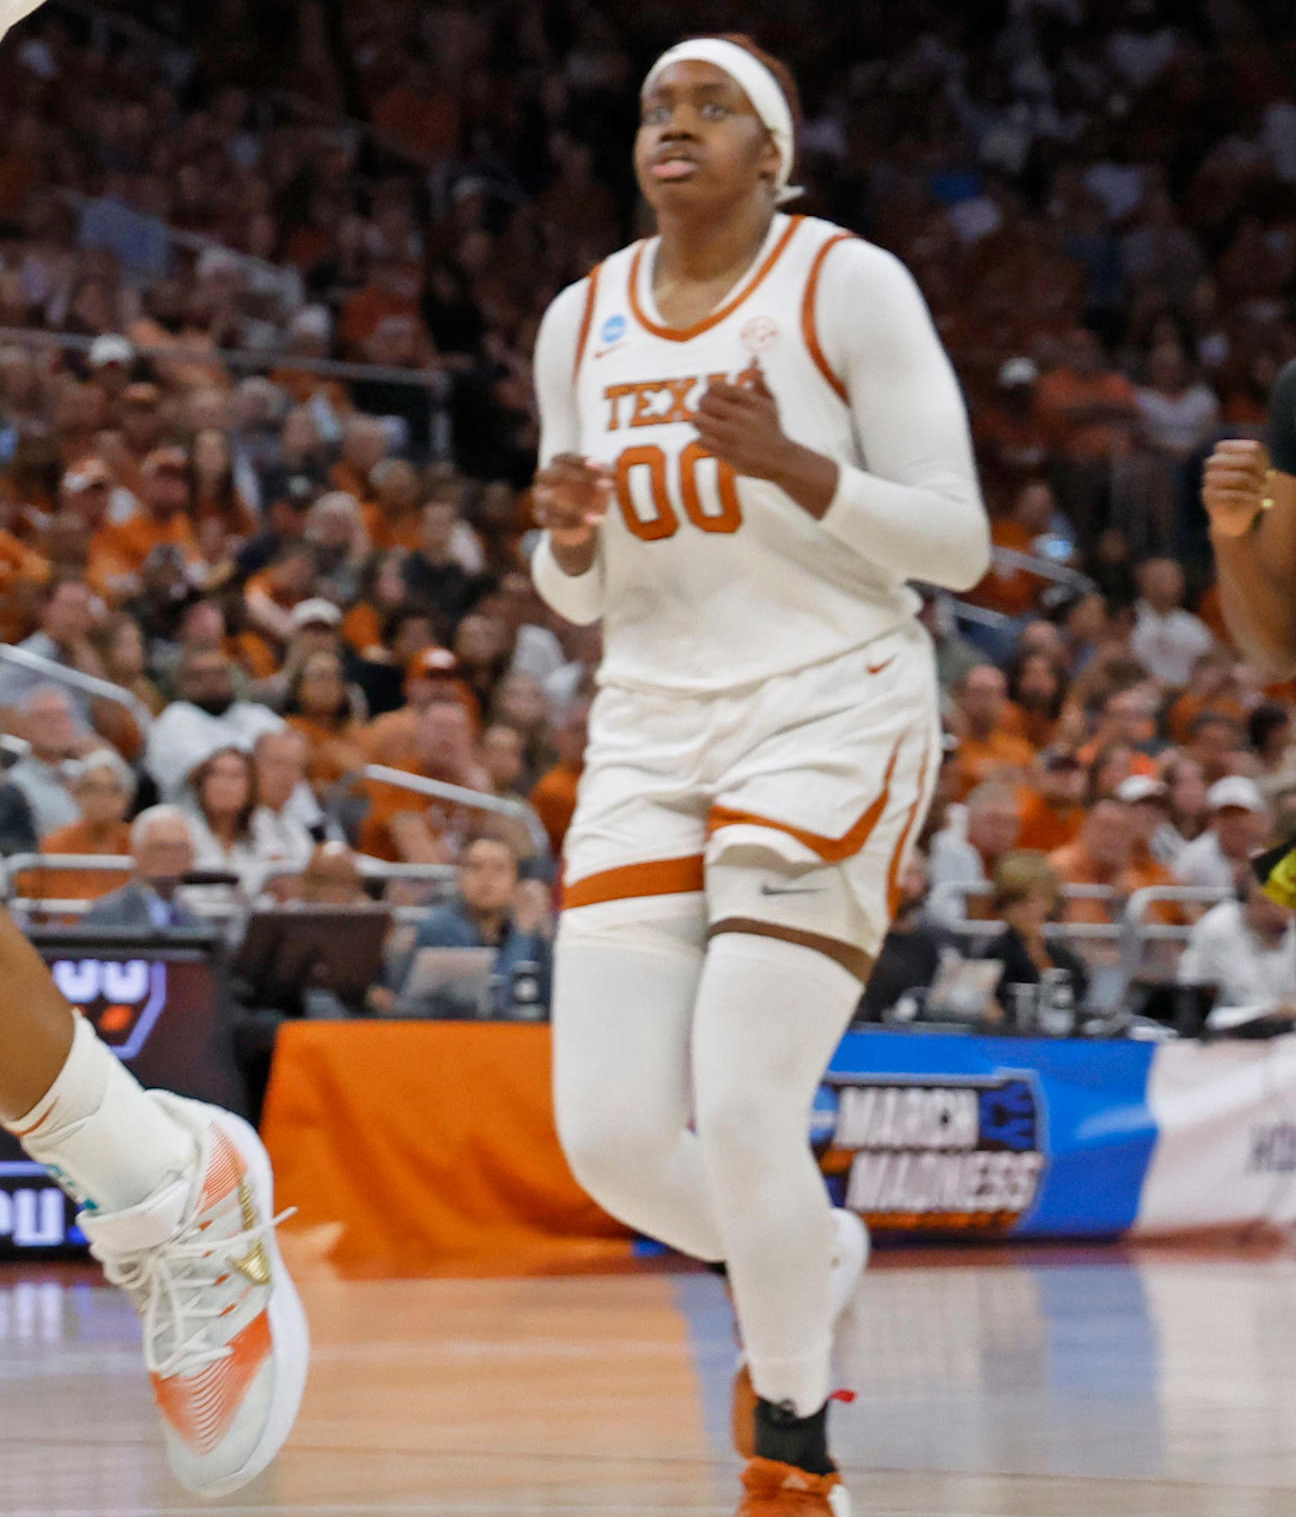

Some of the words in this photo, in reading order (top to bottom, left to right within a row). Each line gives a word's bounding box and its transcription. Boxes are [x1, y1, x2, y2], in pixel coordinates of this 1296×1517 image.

[603, 369, 754, 432] TEX
[616, 441, 743, 542] 00
[834, 1086, 980, 1150] MARCH
[845, 1150, 1035, 1212] MADNESS
